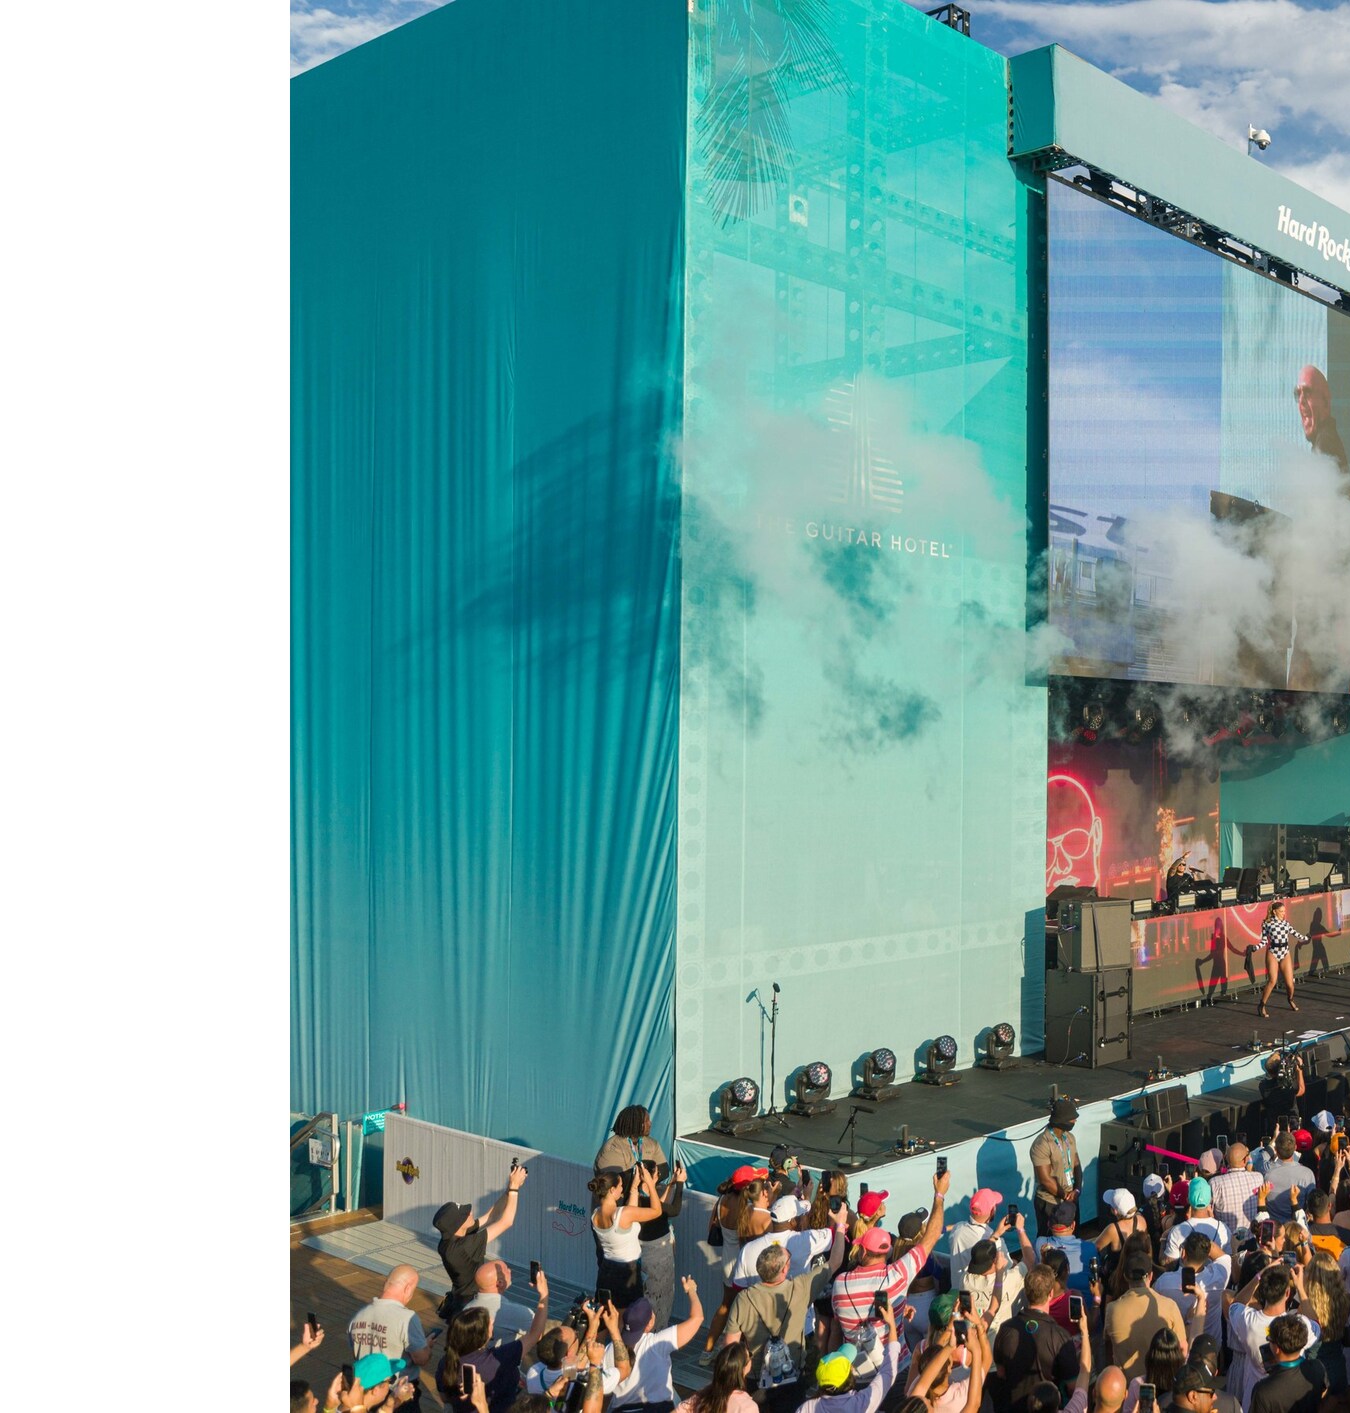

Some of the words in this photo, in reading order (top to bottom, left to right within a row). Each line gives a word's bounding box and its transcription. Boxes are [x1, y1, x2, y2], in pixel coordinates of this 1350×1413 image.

[1277, 204, 1317, 247] Hard
[805, 521, 882, 548] GUITAR
[890, 534, 951, 558] HOTEL
[365, 1112, 387, 1121] NOTIC
[559, 1200, 573, 1211] Hard
[573, 1204, 586, 1216] Rock
[371, 1322, 388, 1334] DADE
